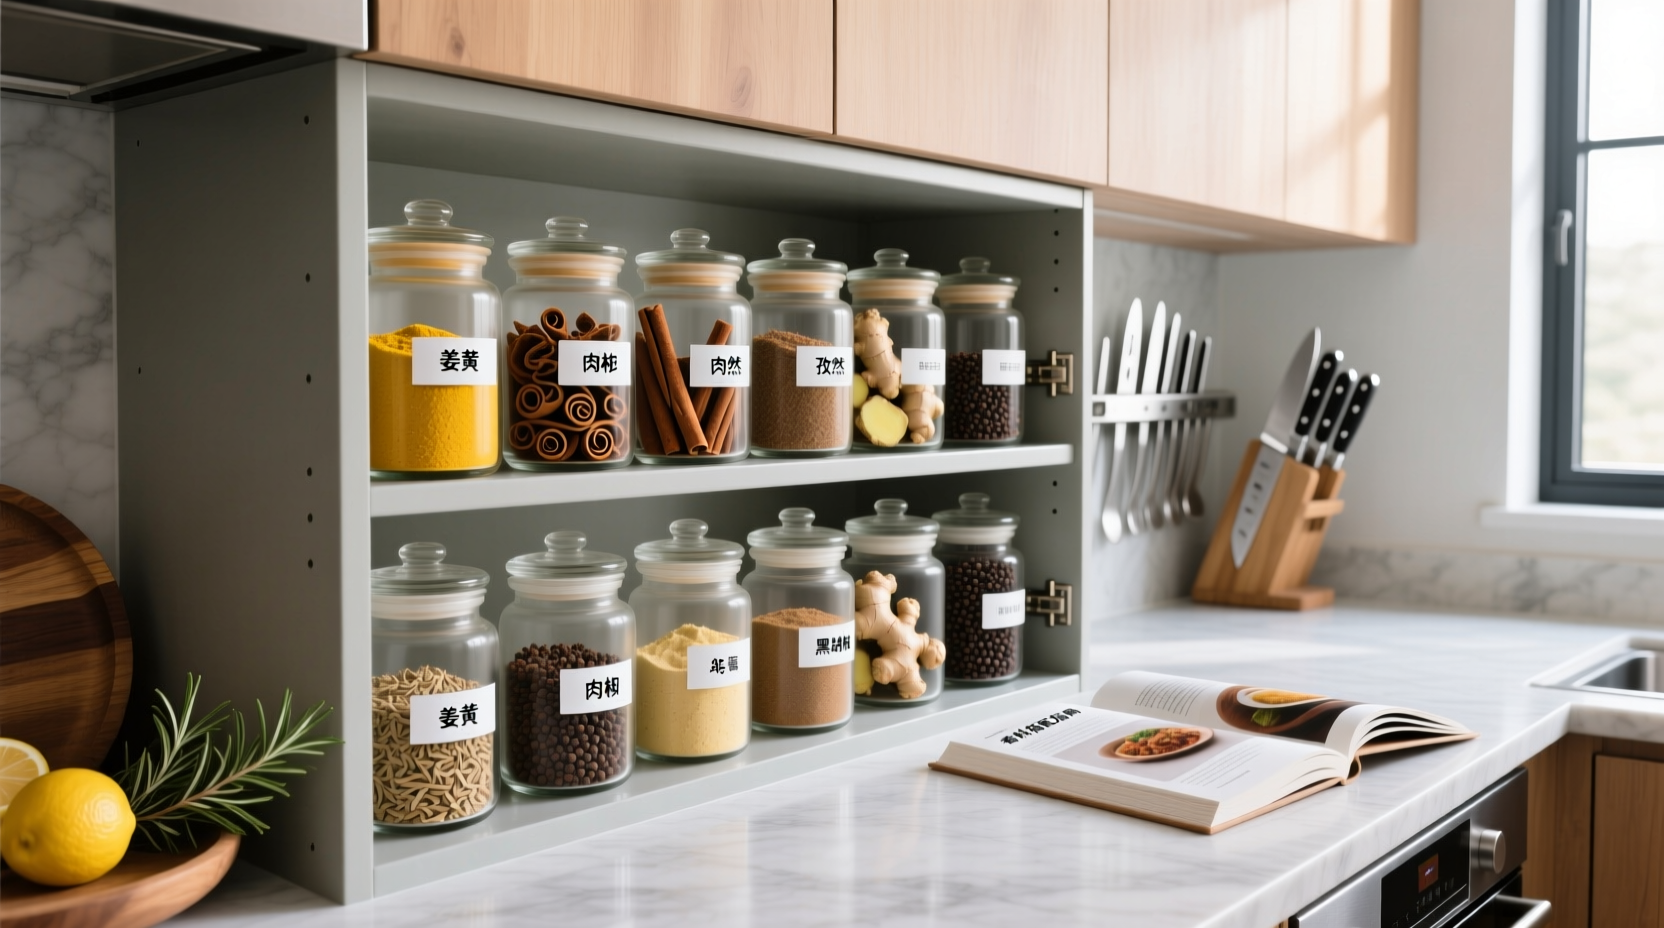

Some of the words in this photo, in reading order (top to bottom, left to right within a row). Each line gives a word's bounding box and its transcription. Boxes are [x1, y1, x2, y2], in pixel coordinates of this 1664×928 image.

[439, 349, 479, 372] 姜黄
[815, 356, 845, 376] 孜然
[438, 702, 479, 729] 姜黄
